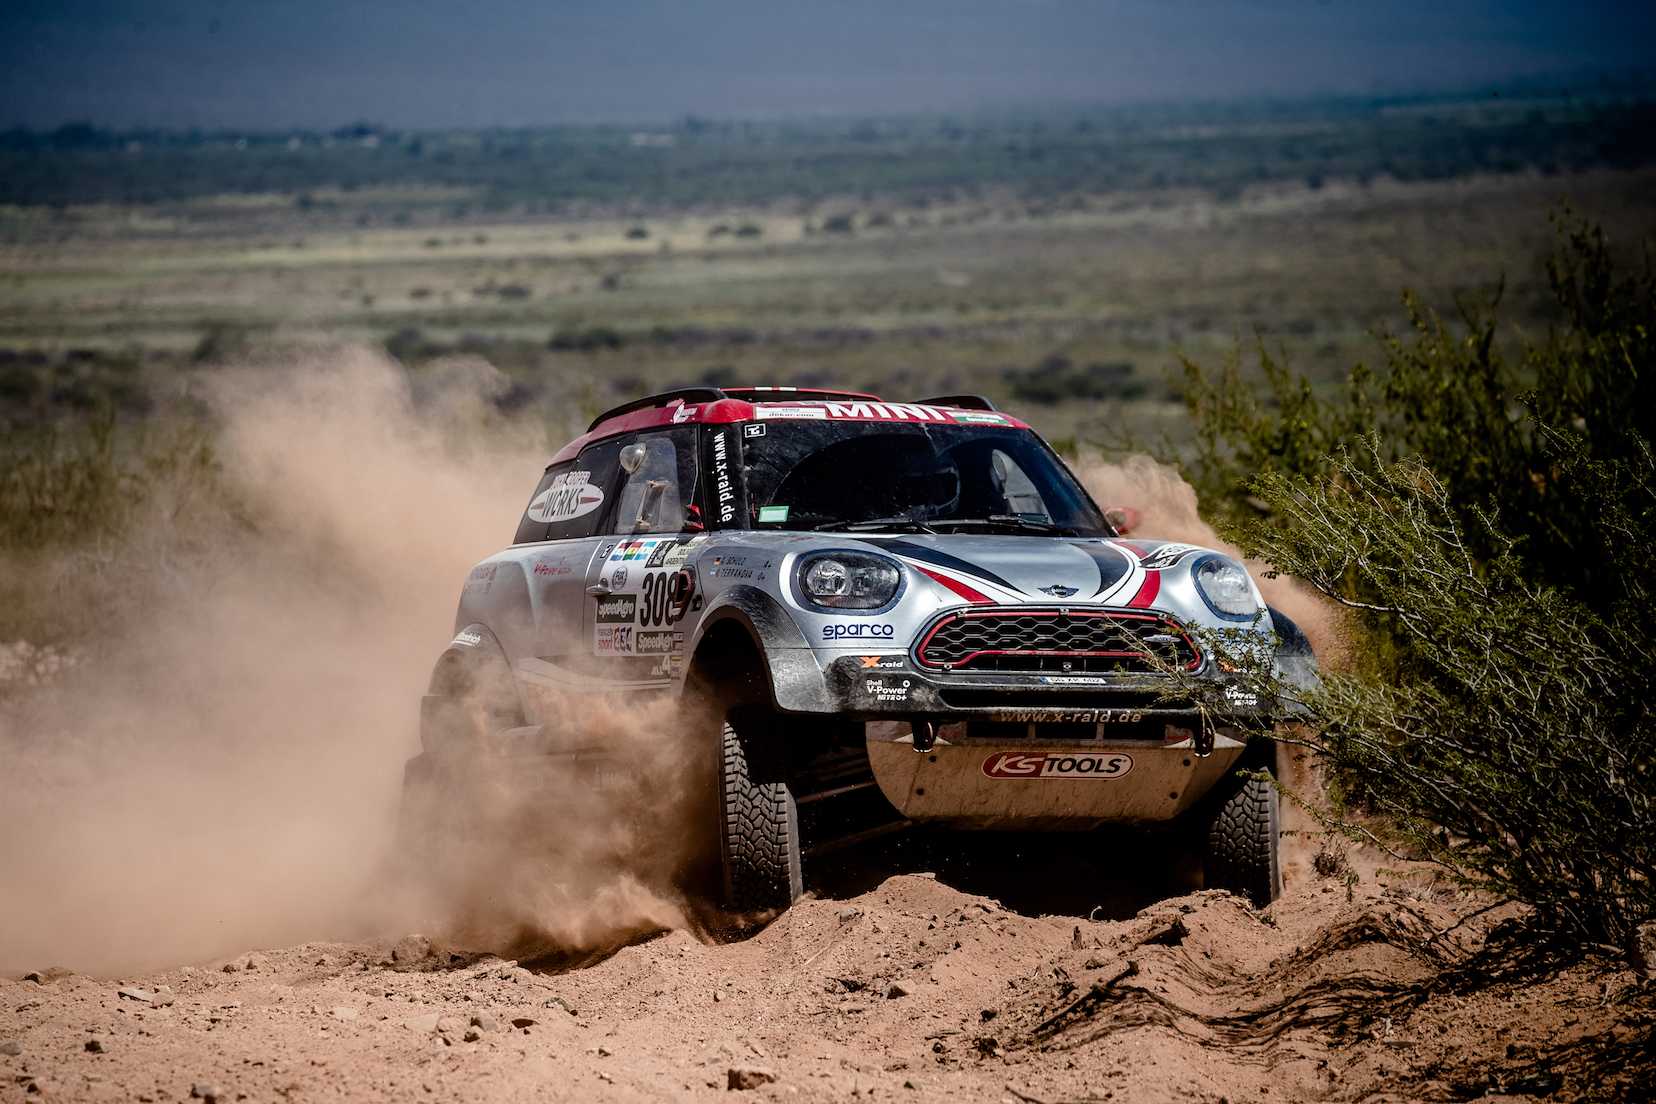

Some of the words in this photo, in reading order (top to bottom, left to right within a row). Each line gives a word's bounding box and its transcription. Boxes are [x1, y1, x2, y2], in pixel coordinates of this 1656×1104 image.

[825, 402, 947, 421] MINI
[714, 431, 735, 522] www.x-raid.de
[542, 488, 584, 517] WORKS
[823, 624, 893, 640] sparco
[867, 685, 907, 695] V-Power
[1001, 710, 1142, 723] www.x-raid.de
[1044, 757, 1121, 774] TOOLS
